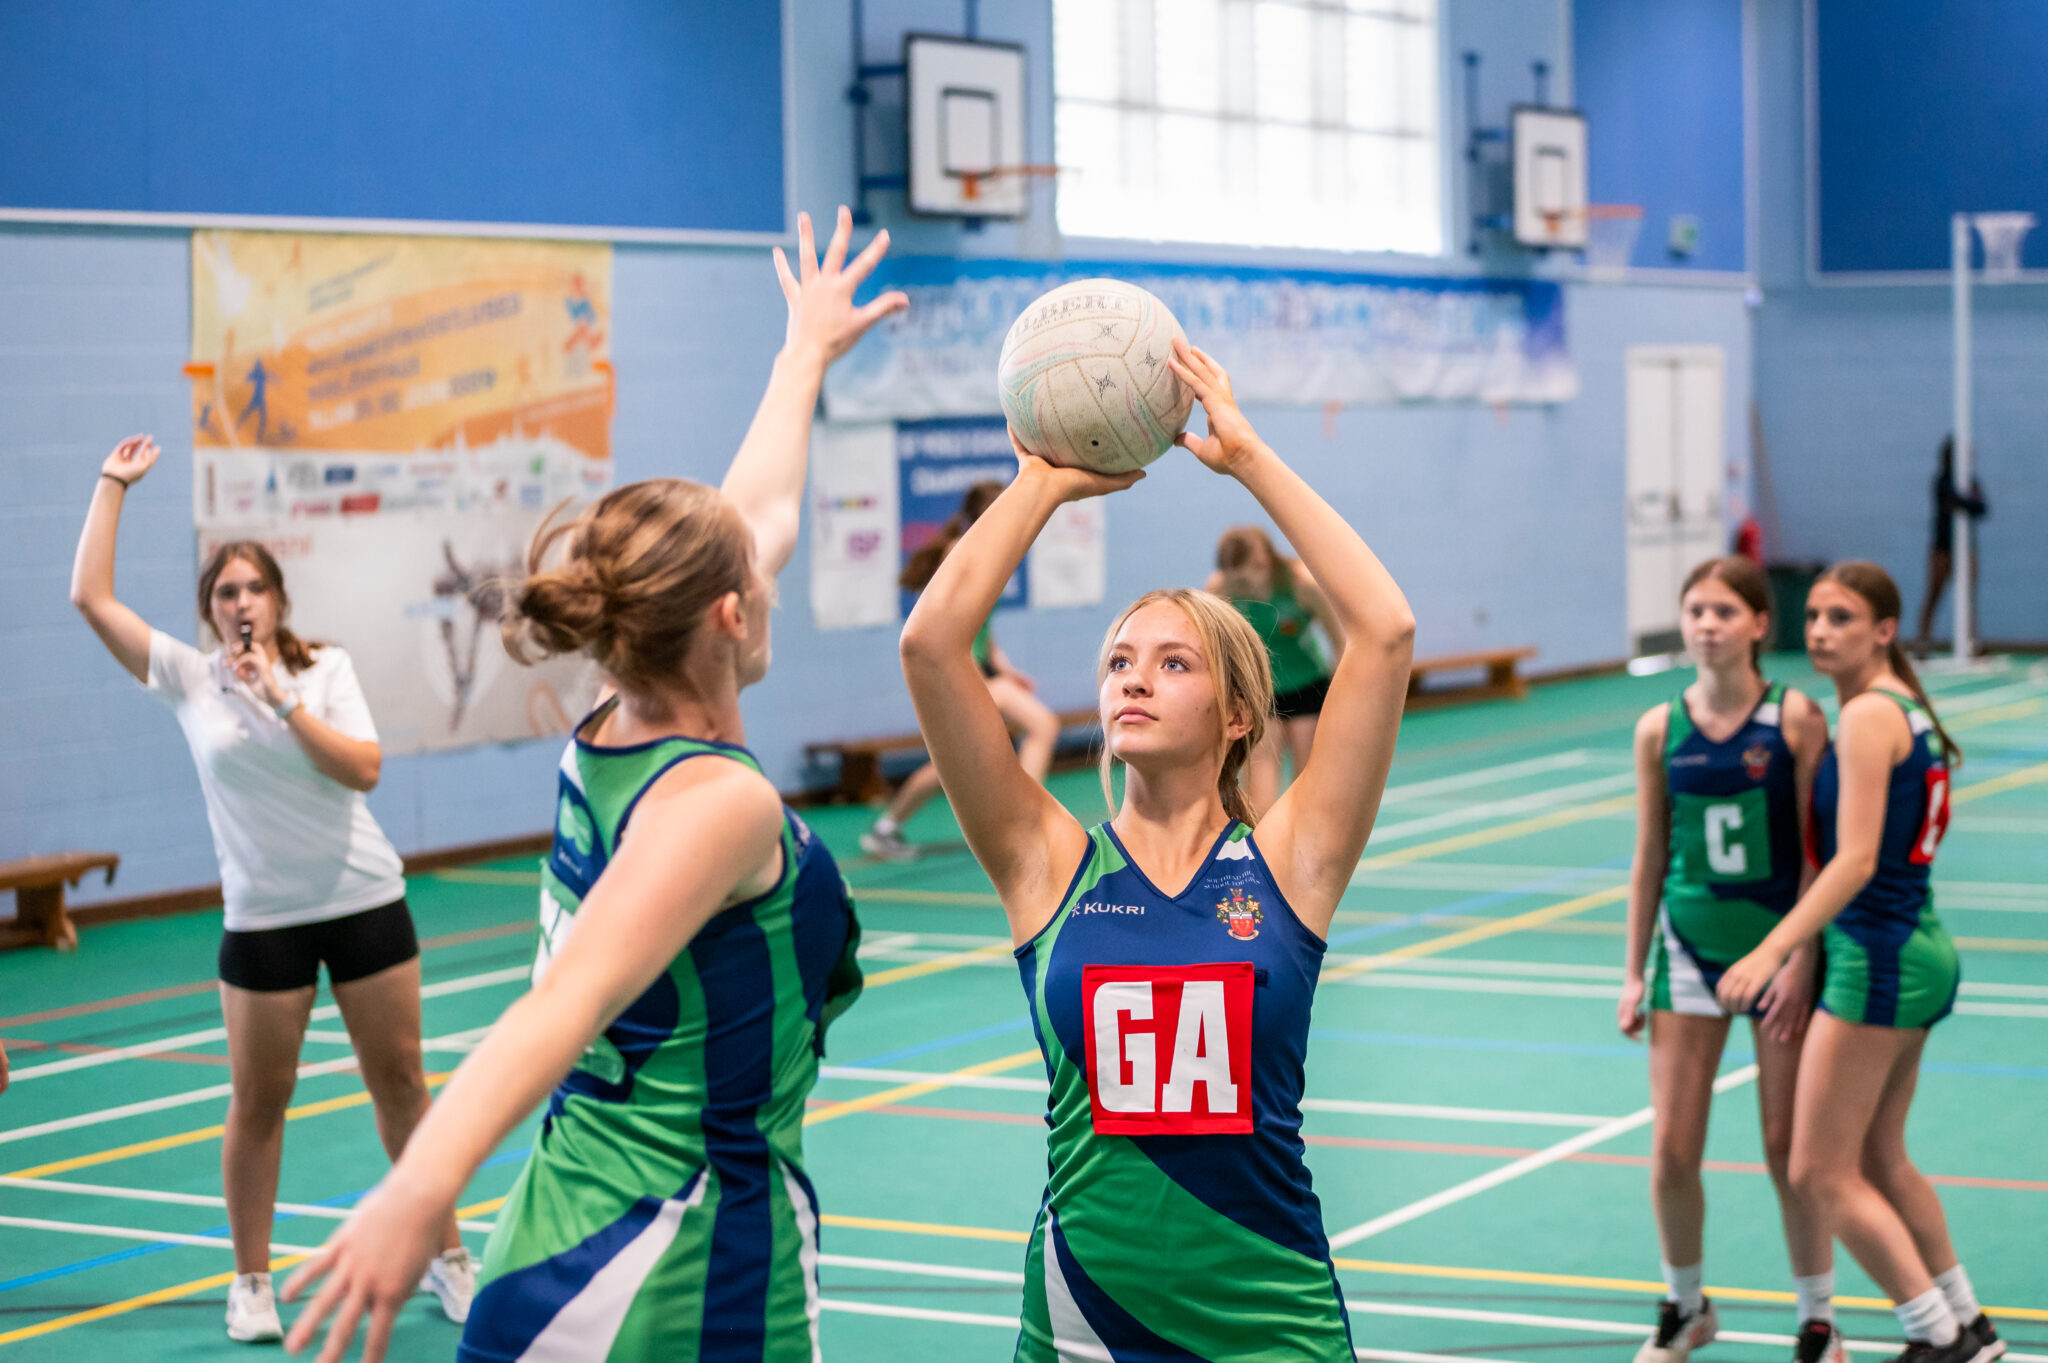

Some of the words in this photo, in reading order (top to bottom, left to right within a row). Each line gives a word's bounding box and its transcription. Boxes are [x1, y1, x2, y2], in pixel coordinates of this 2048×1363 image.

[1013, 295, 1129, 338] ILBERT
[1704, 804, 1746, 875] C
[1084, 901, 1145, 915] KUKRI
[1093, 980, 1238, 1114] GA
